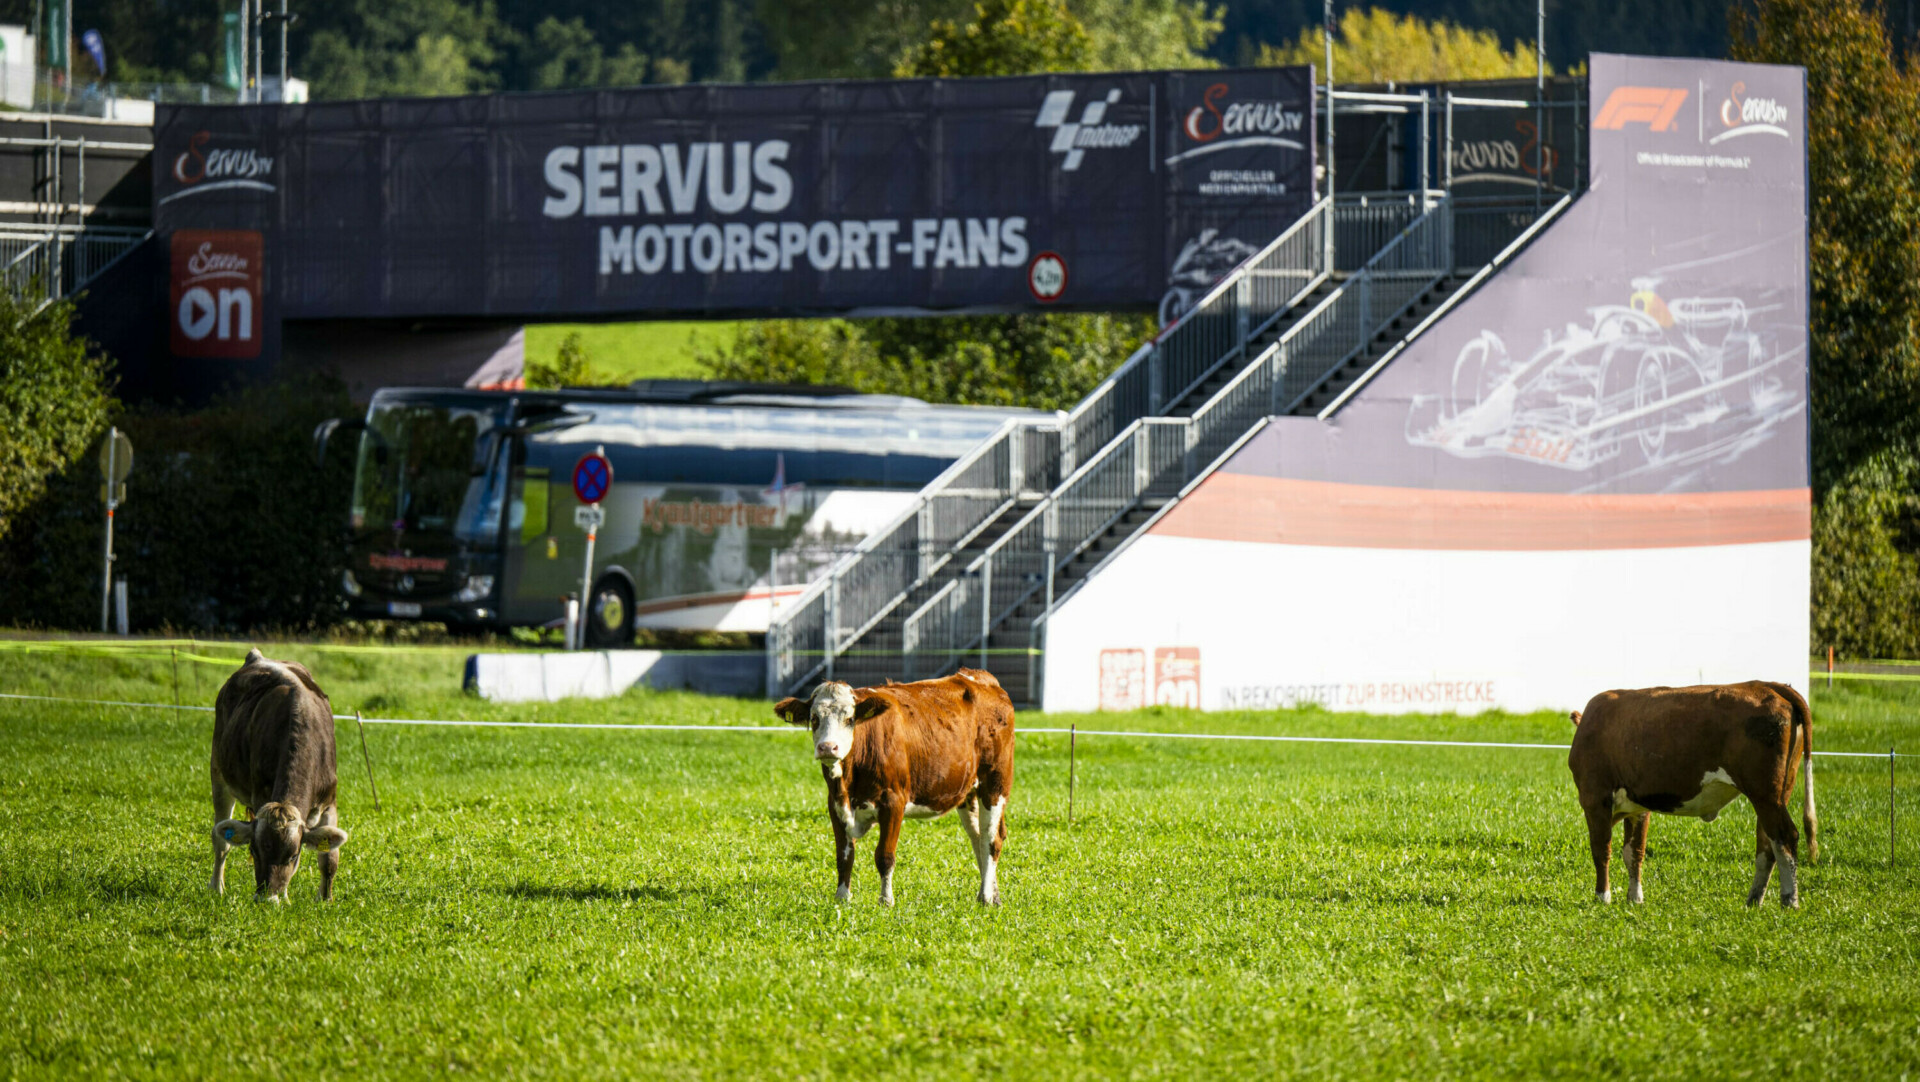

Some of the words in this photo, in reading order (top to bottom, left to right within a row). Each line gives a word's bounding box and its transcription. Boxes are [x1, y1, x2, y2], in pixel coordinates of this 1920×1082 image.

[543, 140, 793, 218] SERVUS
[599, 217, 1028, 274] MOTORSPORT-FANS
[1381, 681, 1495, 703] RENNSTRECKE
